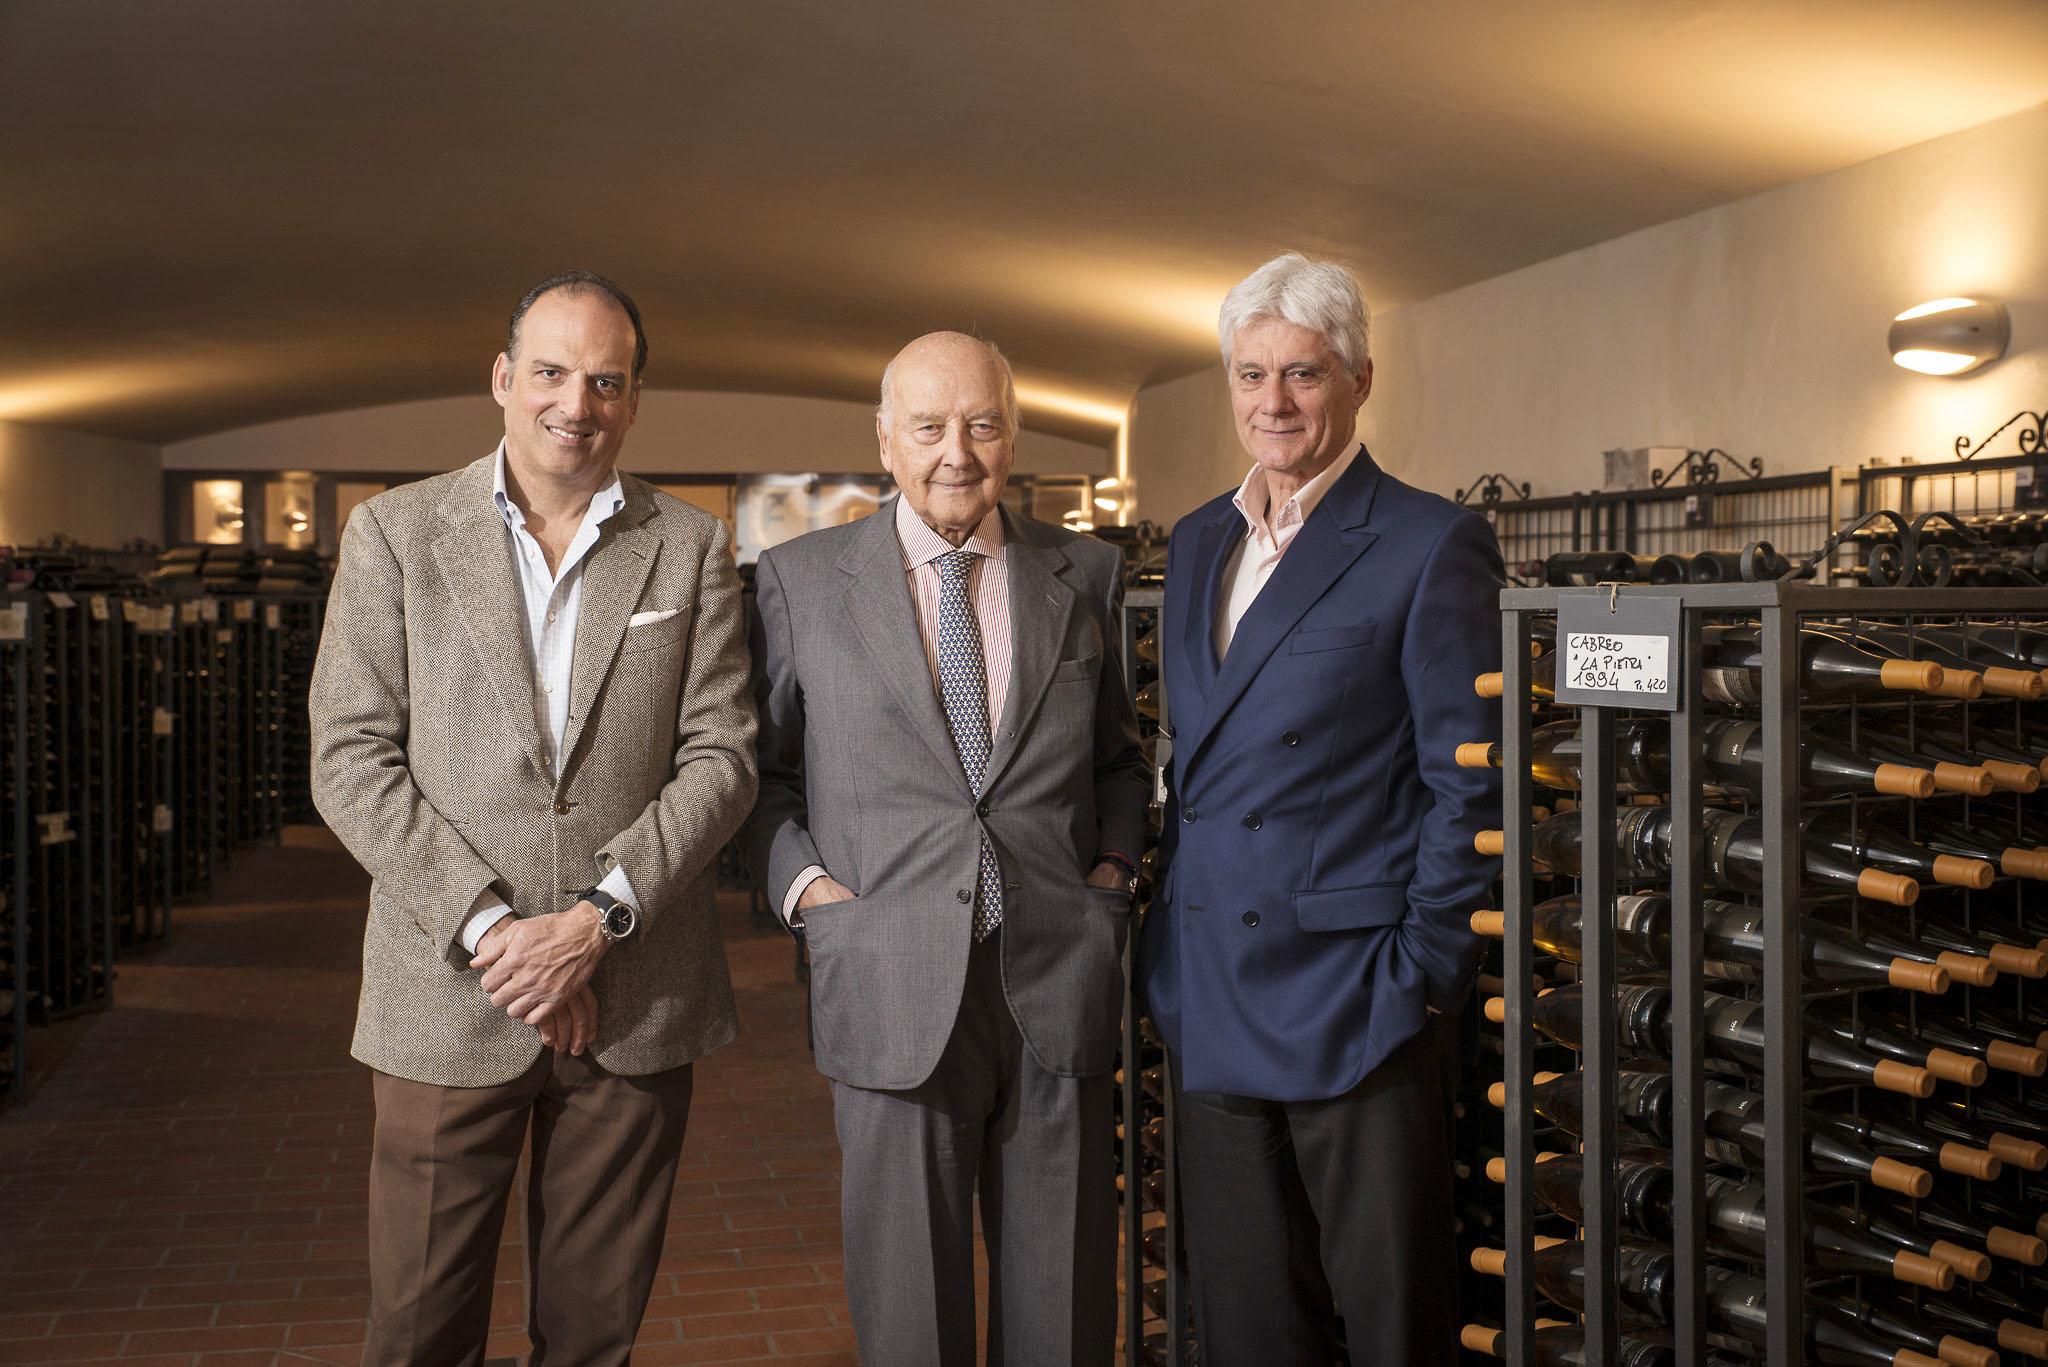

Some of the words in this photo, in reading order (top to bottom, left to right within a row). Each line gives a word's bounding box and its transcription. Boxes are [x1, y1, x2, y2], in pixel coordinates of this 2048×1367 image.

[1571, 636, 1622, 652] CABREO
[1573, 671, 1619, 691] 1994
[1647, 678, 1666, 691] 420
